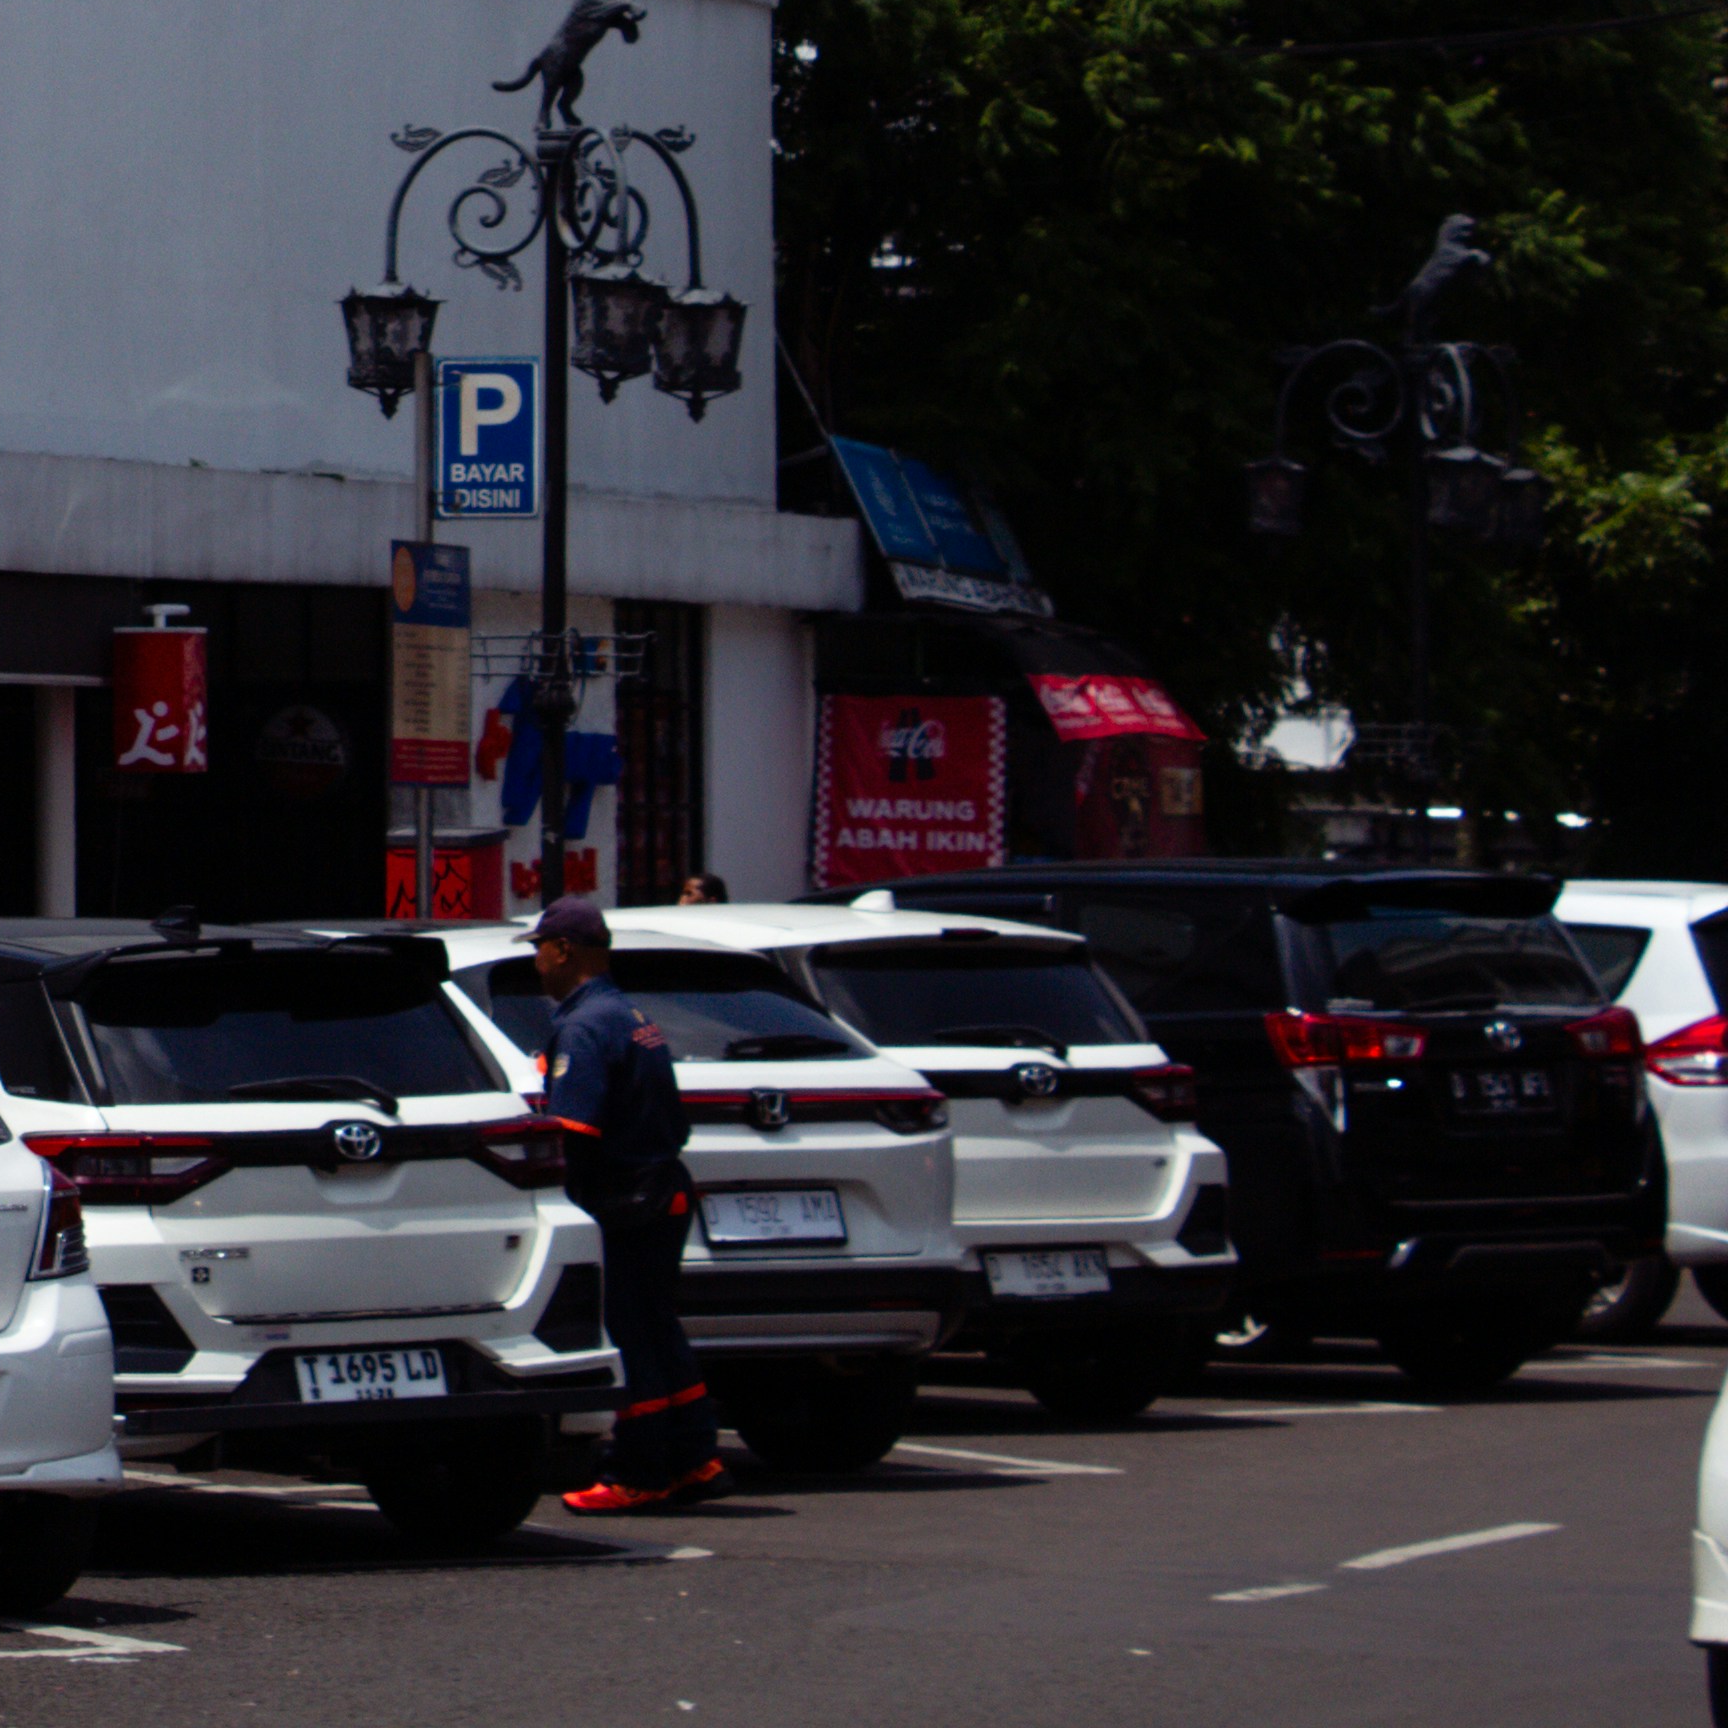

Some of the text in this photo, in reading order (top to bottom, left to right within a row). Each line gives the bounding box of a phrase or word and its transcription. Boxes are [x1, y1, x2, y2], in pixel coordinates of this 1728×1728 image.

[460, 373, 523, 457] P
[450, 463, 526, 483] BAYAR
[455, 488, 521, 509] DISINI
[845, 797, 977, 822] WARUNG
[835, 826, 987, 853] ABAH IKIN
[302, 1350, 439, 1386] T 1695 LD
